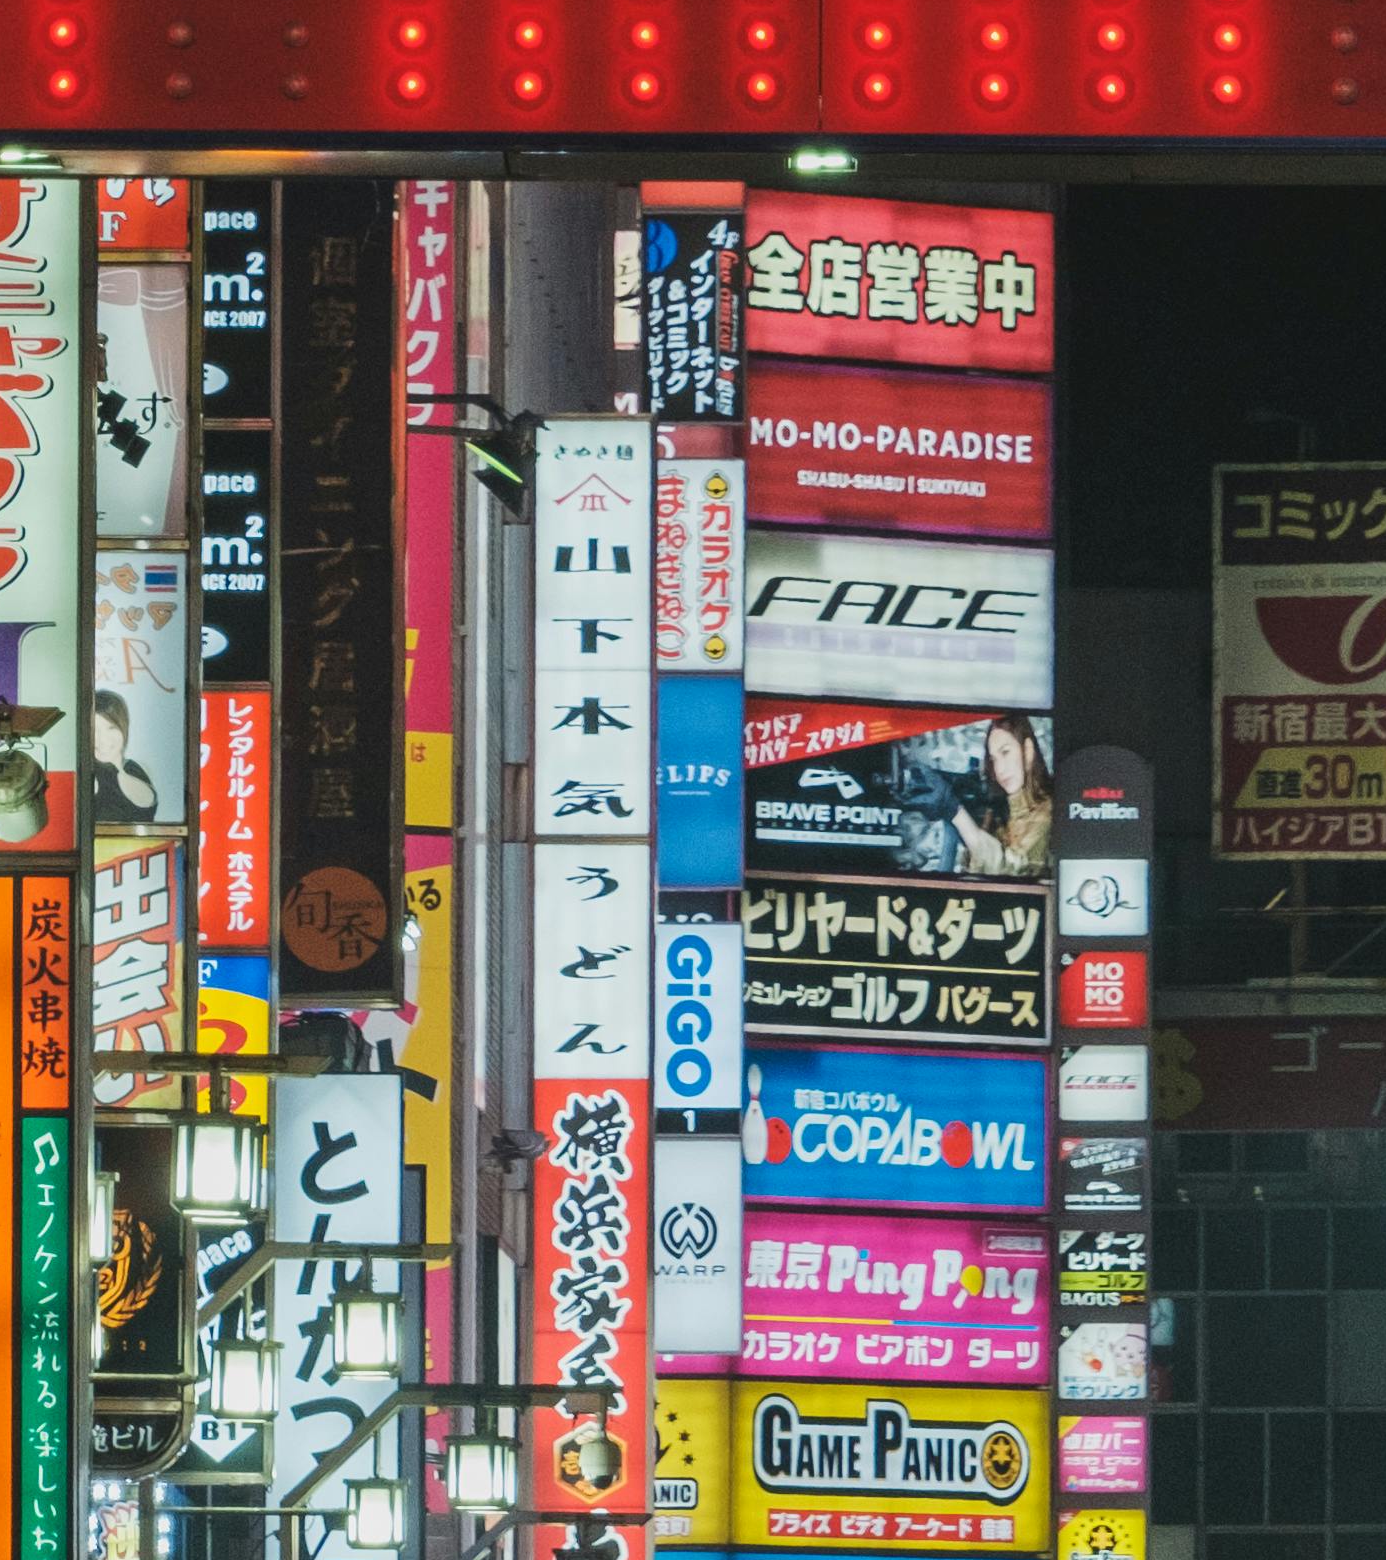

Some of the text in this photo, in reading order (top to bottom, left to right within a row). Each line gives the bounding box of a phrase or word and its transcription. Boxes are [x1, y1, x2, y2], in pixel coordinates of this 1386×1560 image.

[746, 230, 1038, 332] 全店営業中
[228, 310, 267, 329] 2007
[689, 248, 715, 415] インターネット
[749, 415, 1035, 465] MO-MO-PARADISE
[227, 573, 266, 592] 2007
[699, 501, 732, 633] カラオケ
[746, 575, 1041, 634] FACE
[226, 698, 256, 932] レンタルルーム ホステル
[754, 799, 904, 827] BRAVE POINT
[1068, 800, 1140, 821] Pavilion
[743, 890, 1042, 968] ビリヤード&ダーツ
[23, 896, 69, 1080] 炭火串焼
[665, 933, 715, 1099] GiGO
[830, 972, 931, 1027] ゴルフ
[935, 983, 1042, 1031] バグース
[746, 1237, 822, 1291] 東京
[826, 1243, 928, 1312] Ping
[742, 1329, 842, 1365] カラオケ
[967, 1336, 1041, 1371] ダーツ
